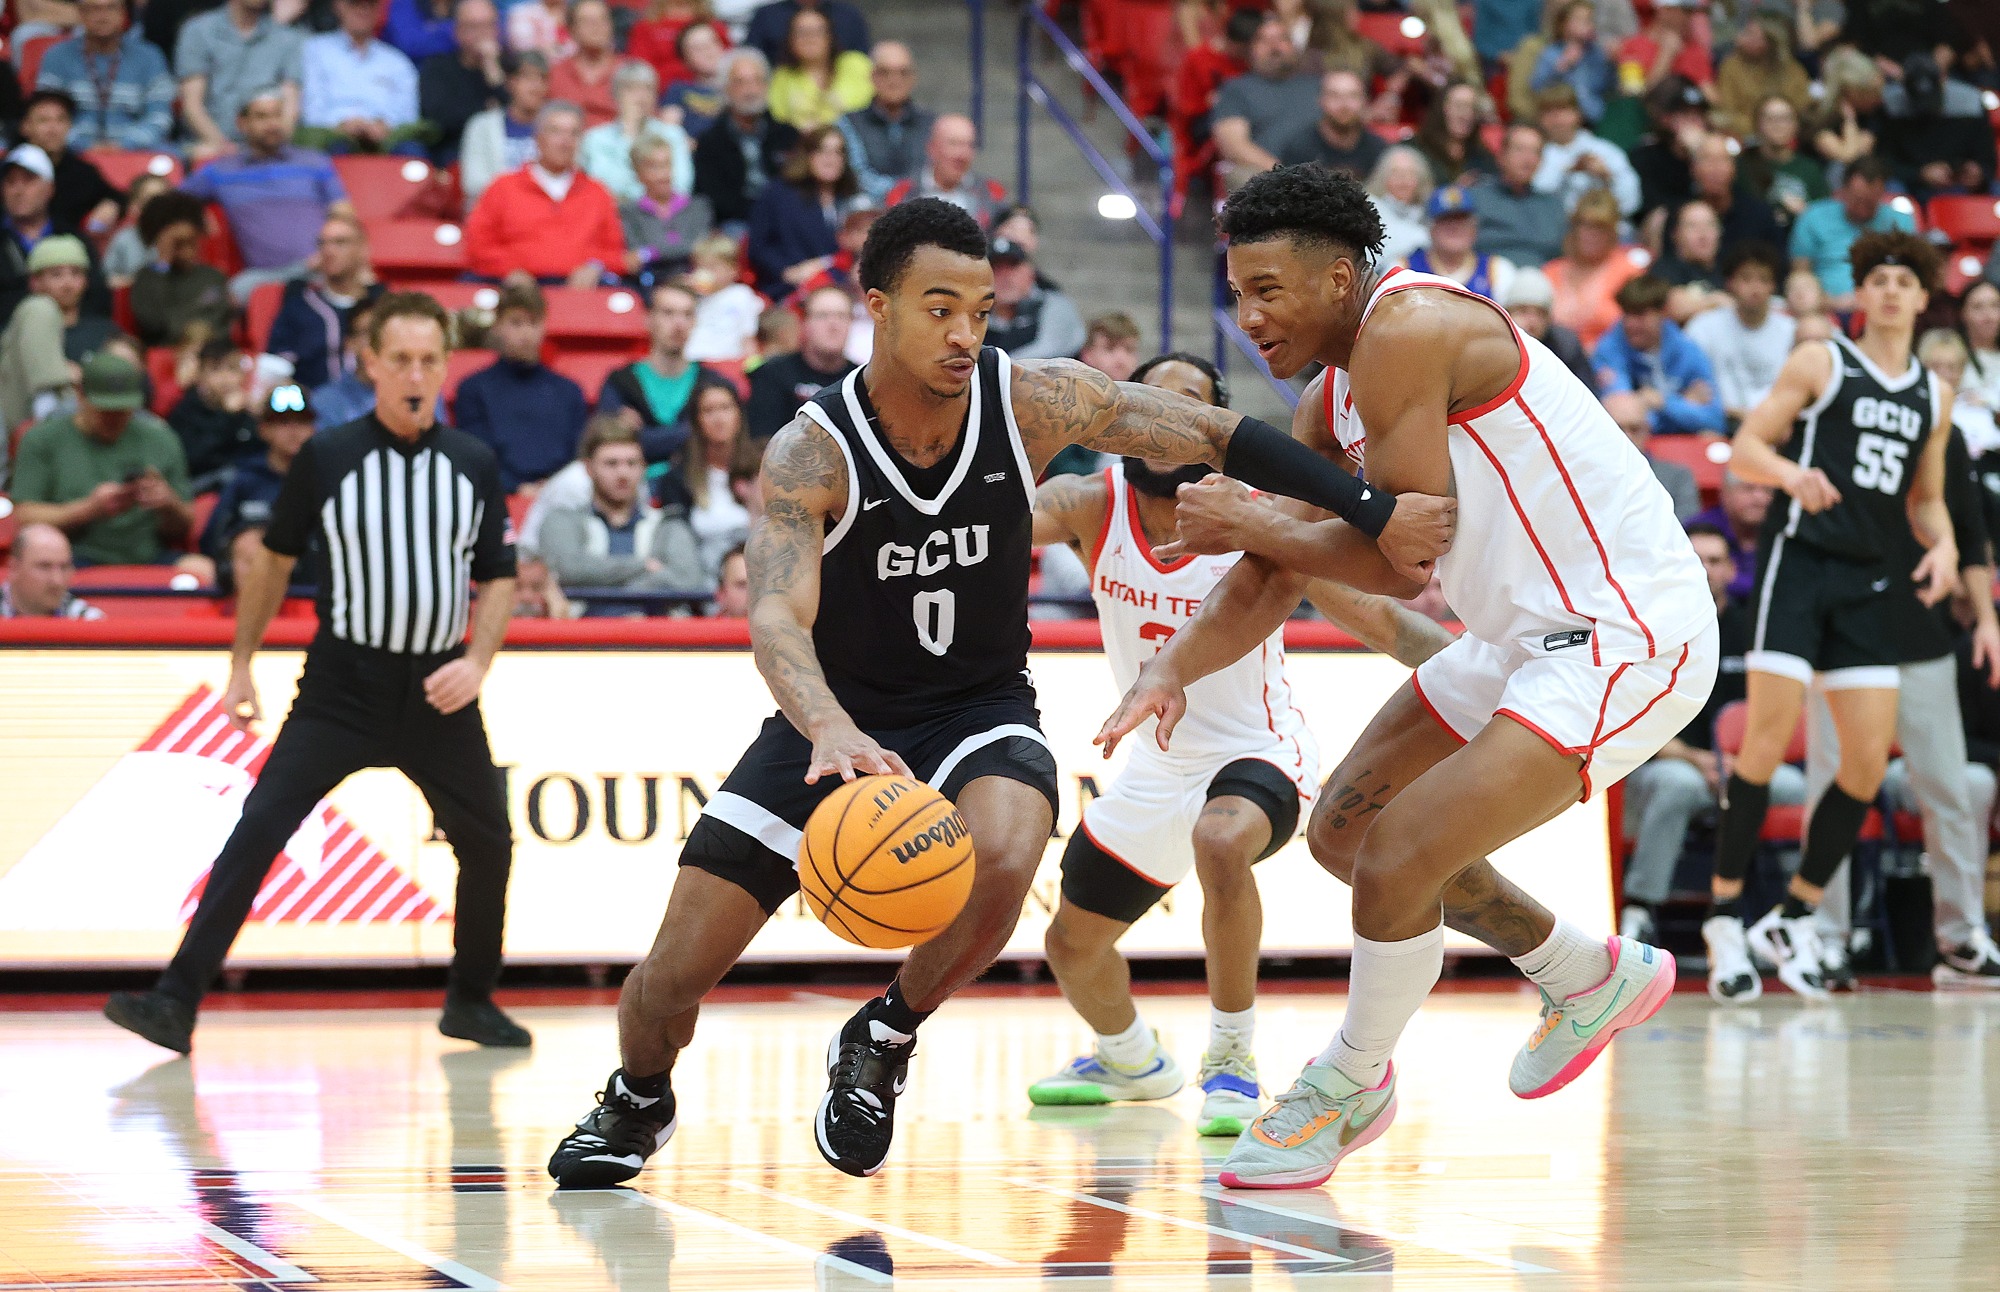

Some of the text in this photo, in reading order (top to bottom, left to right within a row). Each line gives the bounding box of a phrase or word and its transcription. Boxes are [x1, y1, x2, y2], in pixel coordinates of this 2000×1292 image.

[1852, 396, 1922, 441] GCU
[1852, 431, 1909, 495] 55
[877, 524, 990, 581] GCU
[1100, 575, 1158, 611] UTAH
[913, 588, 955, 656] 0
[1572, 633, 1584, 641] XL
[494, 765, 712, 843] OUN
